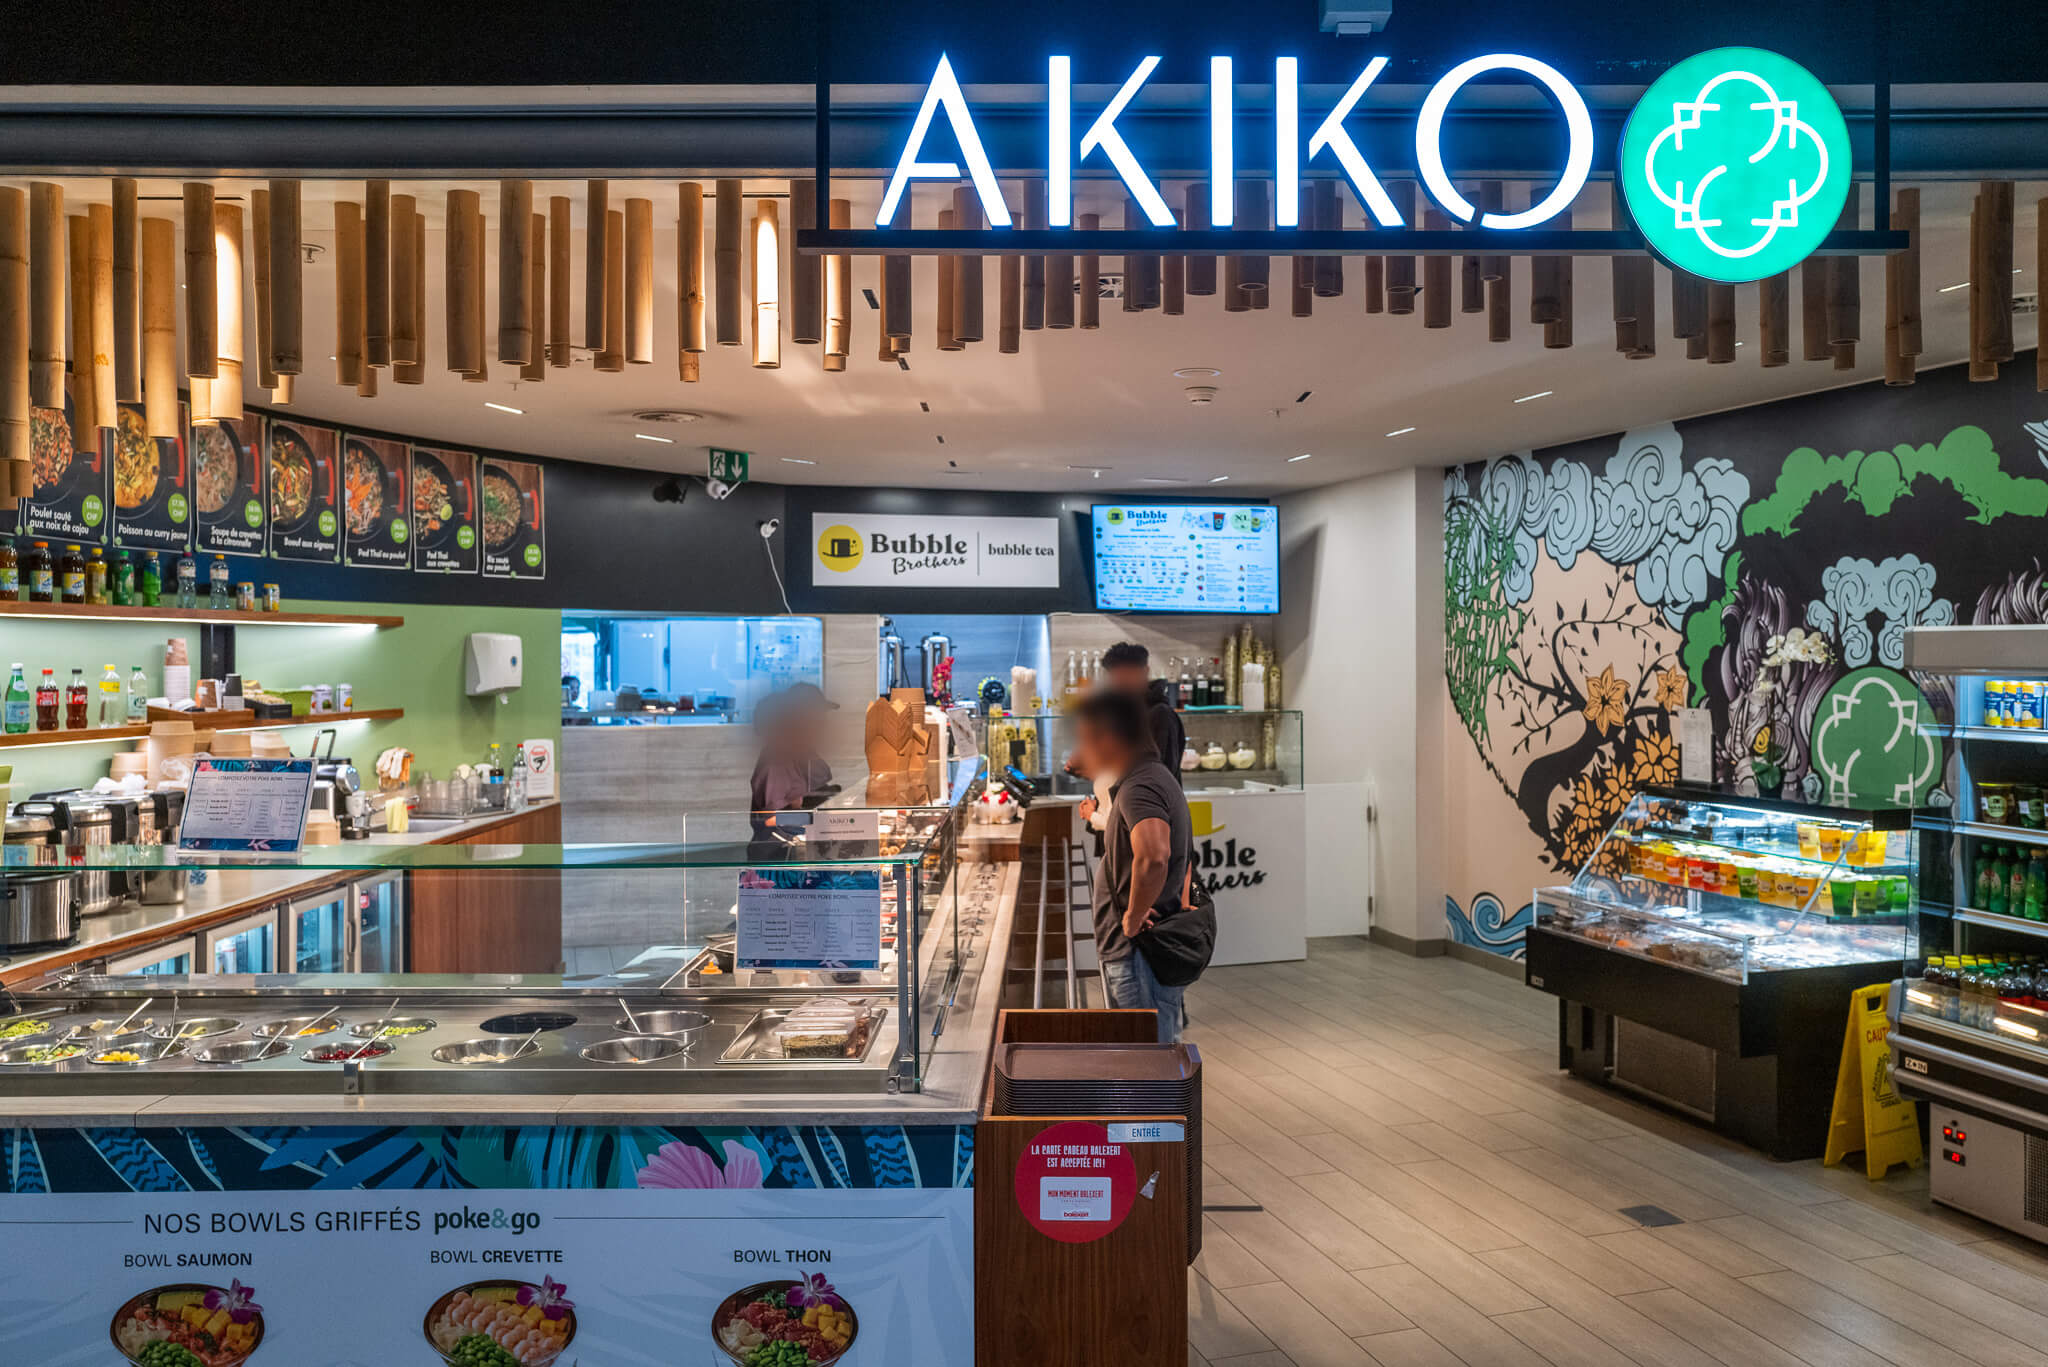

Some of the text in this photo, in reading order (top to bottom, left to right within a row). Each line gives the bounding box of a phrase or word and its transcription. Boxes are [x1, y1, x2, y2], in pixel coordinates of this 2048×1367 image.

[874, 50, 1595, 230] AKIKO
[30, 506, 72, 521] Poulet sauté
[1127, 510, 1168, 519] Bubble
[30, 520, 90, 536] aux noix de cajou
[118, 524, 143, 536] Poisson
[154, 530, 170, 539] curry
[170, 530, 188, 541] jaune
[211, 526, 230, 536] Soupe
[230, 528, 238, 536] de
[216, 538, 222, 546] la
[358, 549, 369, 558] Pad
[389, 552, 406, 560] poulet
[426, 551, 437, 560] Pad
[870, 533, 968, 575] Bubble Brothers
[988, 543, 1055, 556] bubble tea
[1132, 1127, 1161, 1138] ENTRÉE
[1031, 1145, 1121, 1156] LA CARTE CADEAU BALEXERT
[1047, 1158, 1058, 1168] EST
[1060, 1156, 1091, 1168] ACCEPTÉE
[1048, 1190, 1059, 1198] MON
[1060, 1190, 1078, 1198] MOMENT
[144, 1205, 541, 1235] NOS BOWLS GRIFFÉS poke&go
[124, 1252, 253, 1268] BOWL SAUMON
[430, 1249, 564, 1264] BOWL CREVETTE
[734, 1249, 831, 1264] BOWL THON
